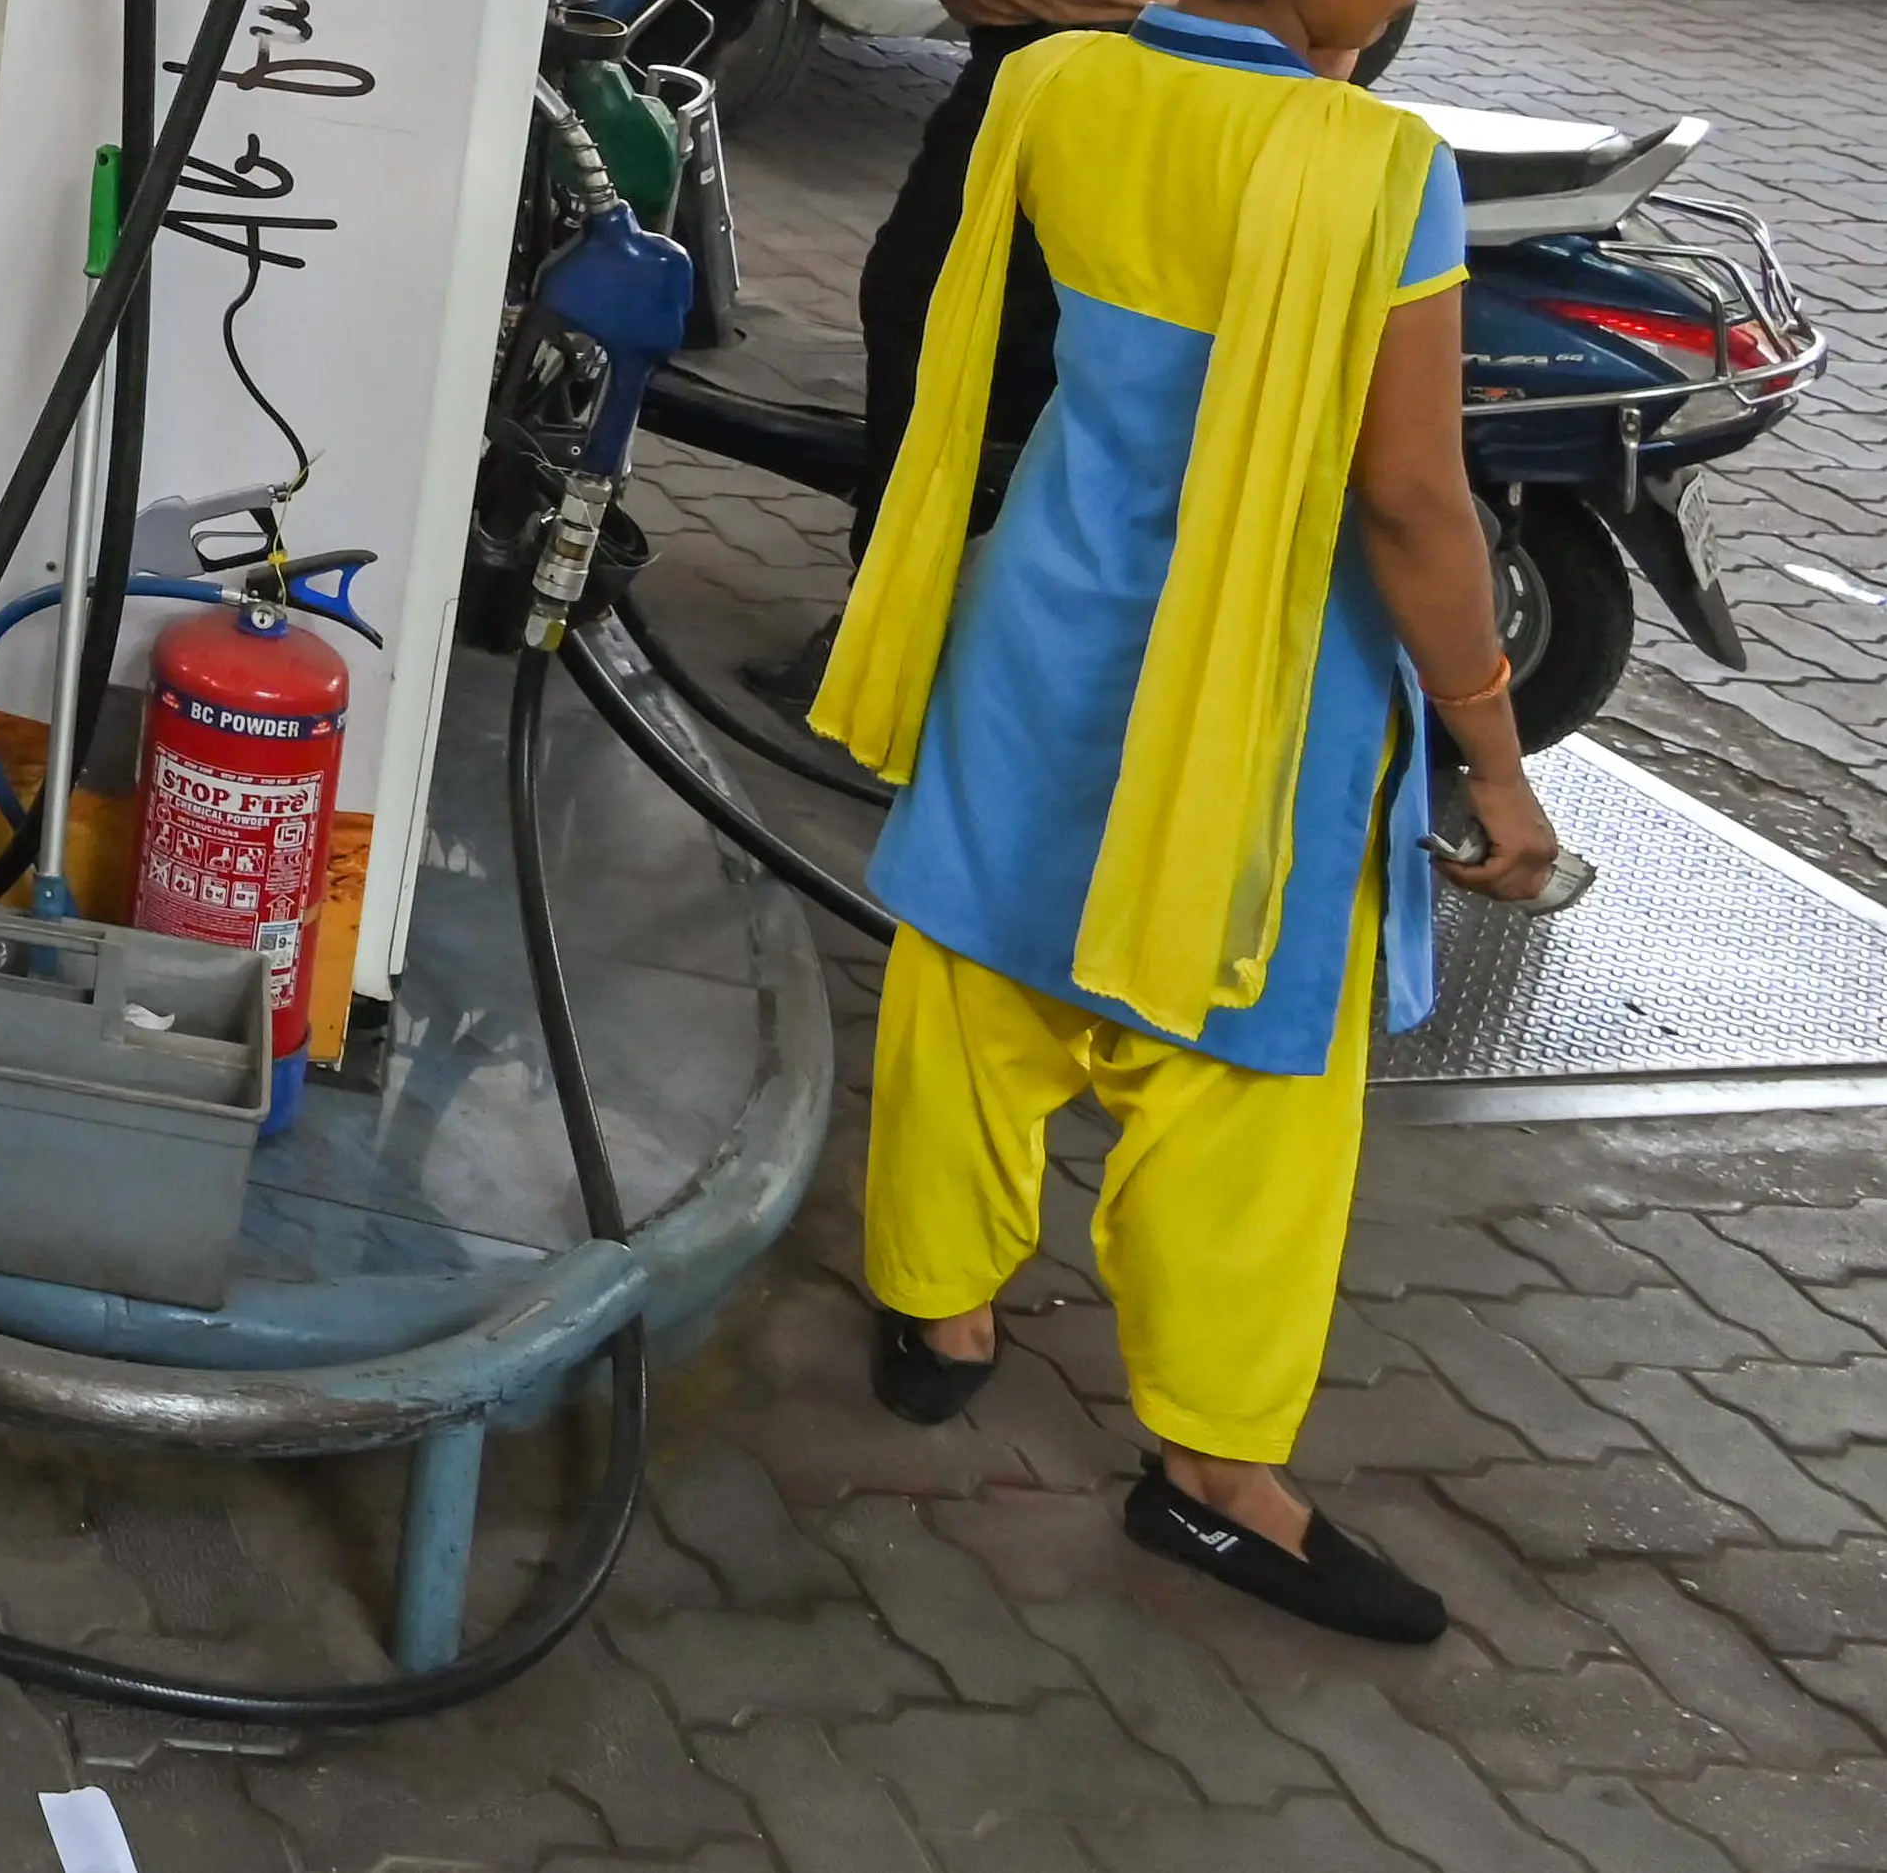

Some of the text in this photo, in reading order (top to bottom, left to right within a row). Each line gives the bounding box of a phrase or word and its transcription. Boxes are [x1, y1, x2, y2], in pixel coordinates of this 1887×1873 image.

[190, 702, 300, 738] BC POWDER
[162, 768, 309, 814] STOP Fire
[176, 799, 223, 821] CHEMICAL
[227, 812, 270, 826] POWDER
